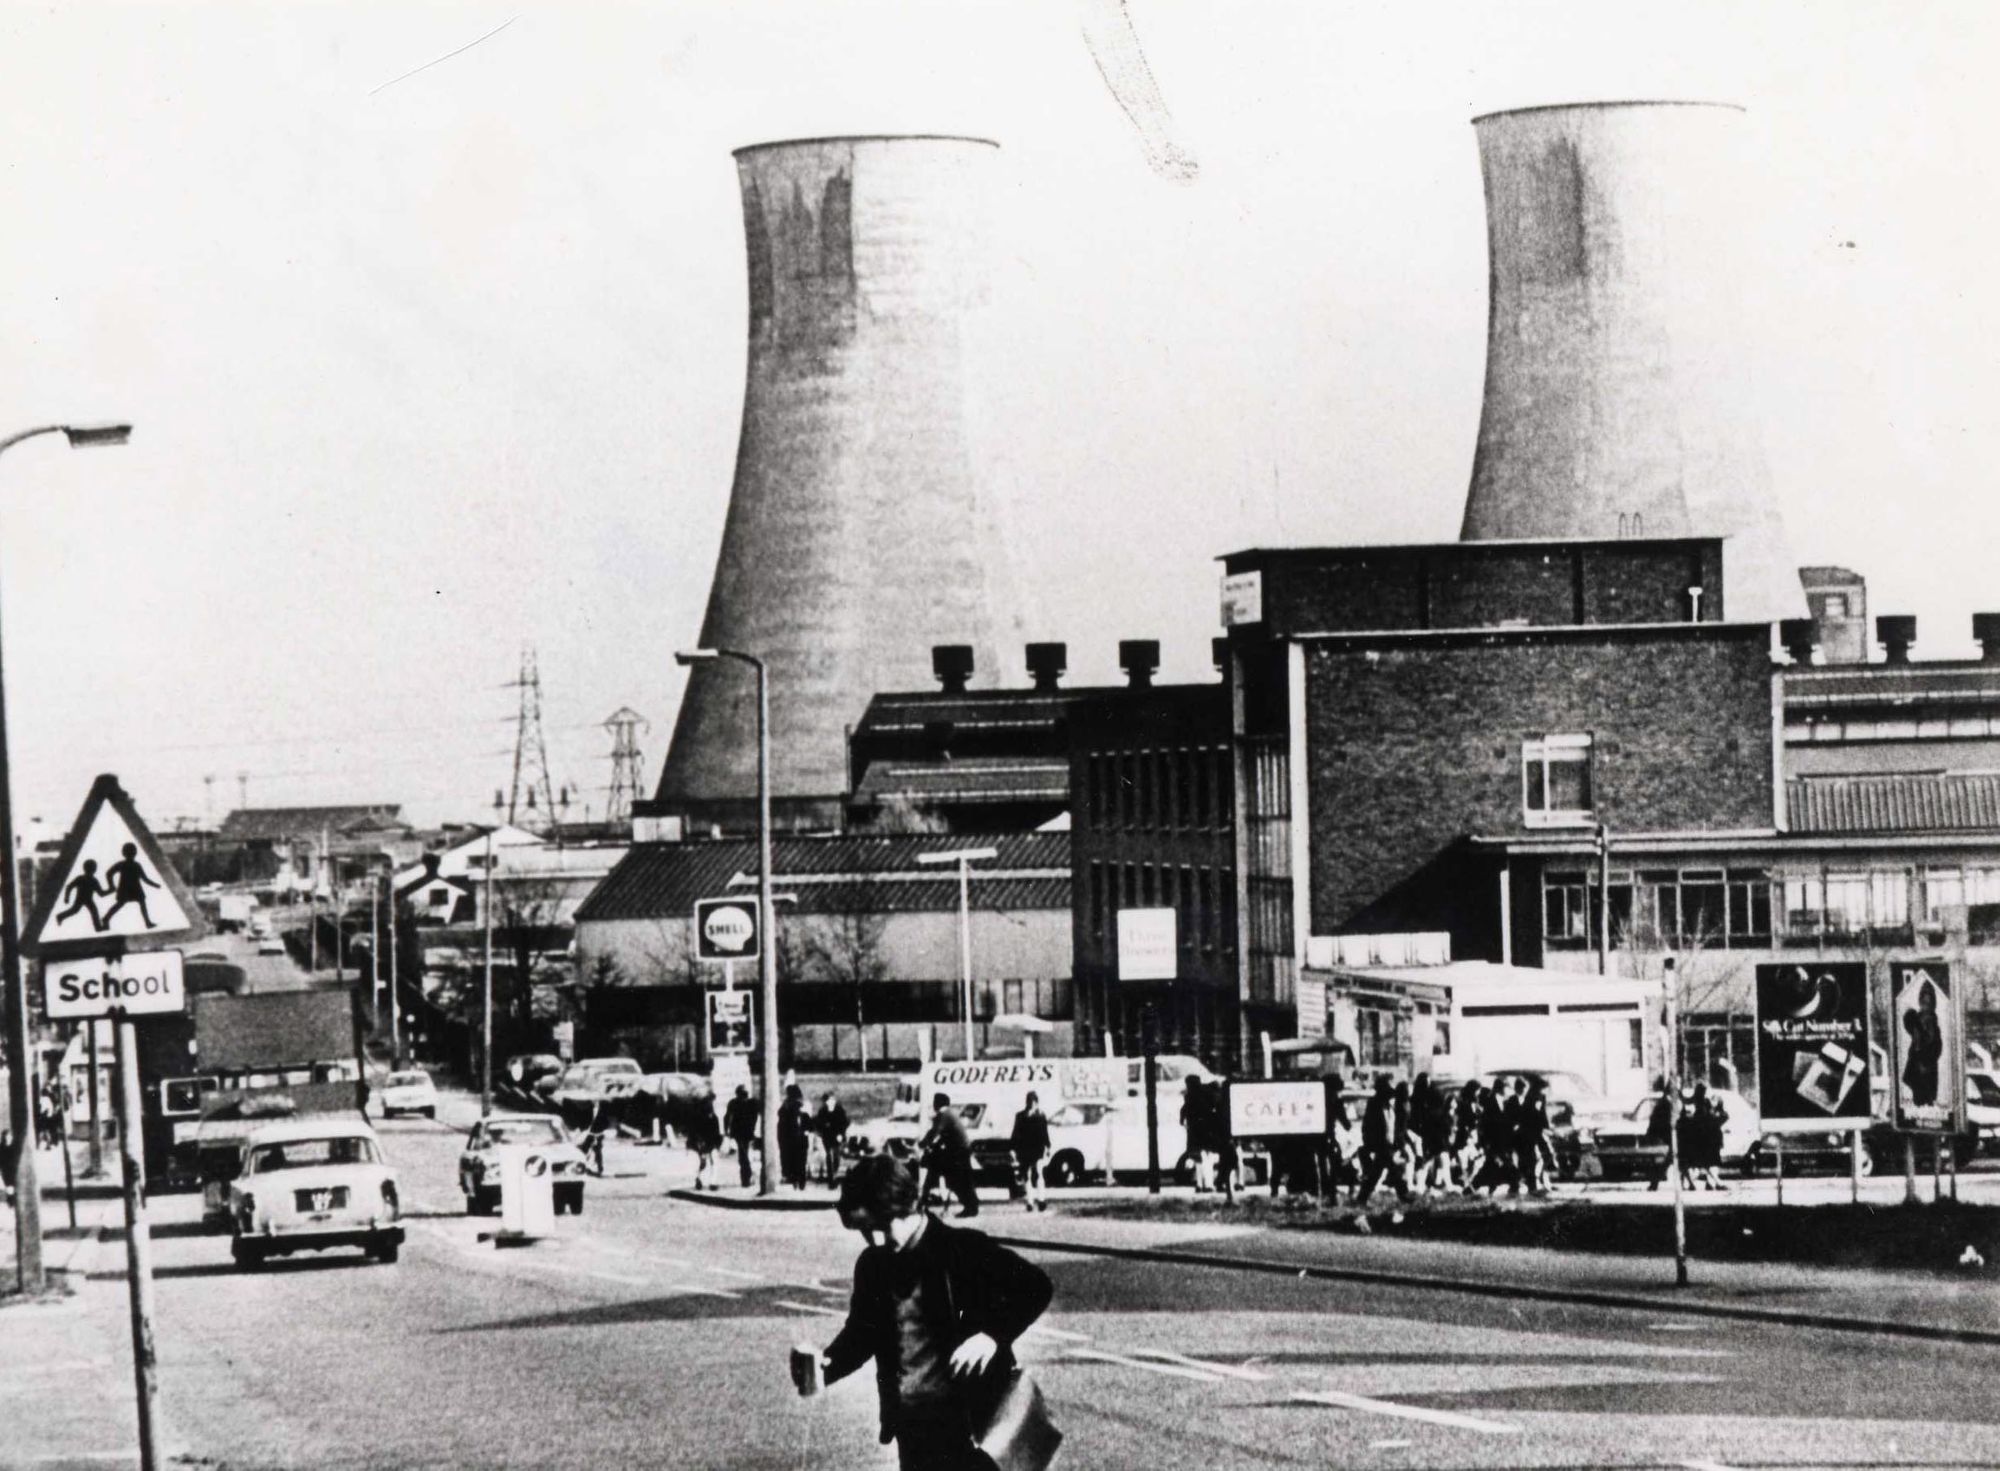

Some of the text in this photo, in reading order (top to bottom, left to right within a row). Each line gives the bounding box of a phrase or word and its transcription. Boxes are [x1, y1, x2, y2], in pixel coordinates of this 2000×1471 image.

[707, 924, 745, 936] SHELL
[58, 968, 170, 1002] School
[1806, 1018, 1852, 1032] Number
[933, 1063, 1055, 1085] GODFREYS
